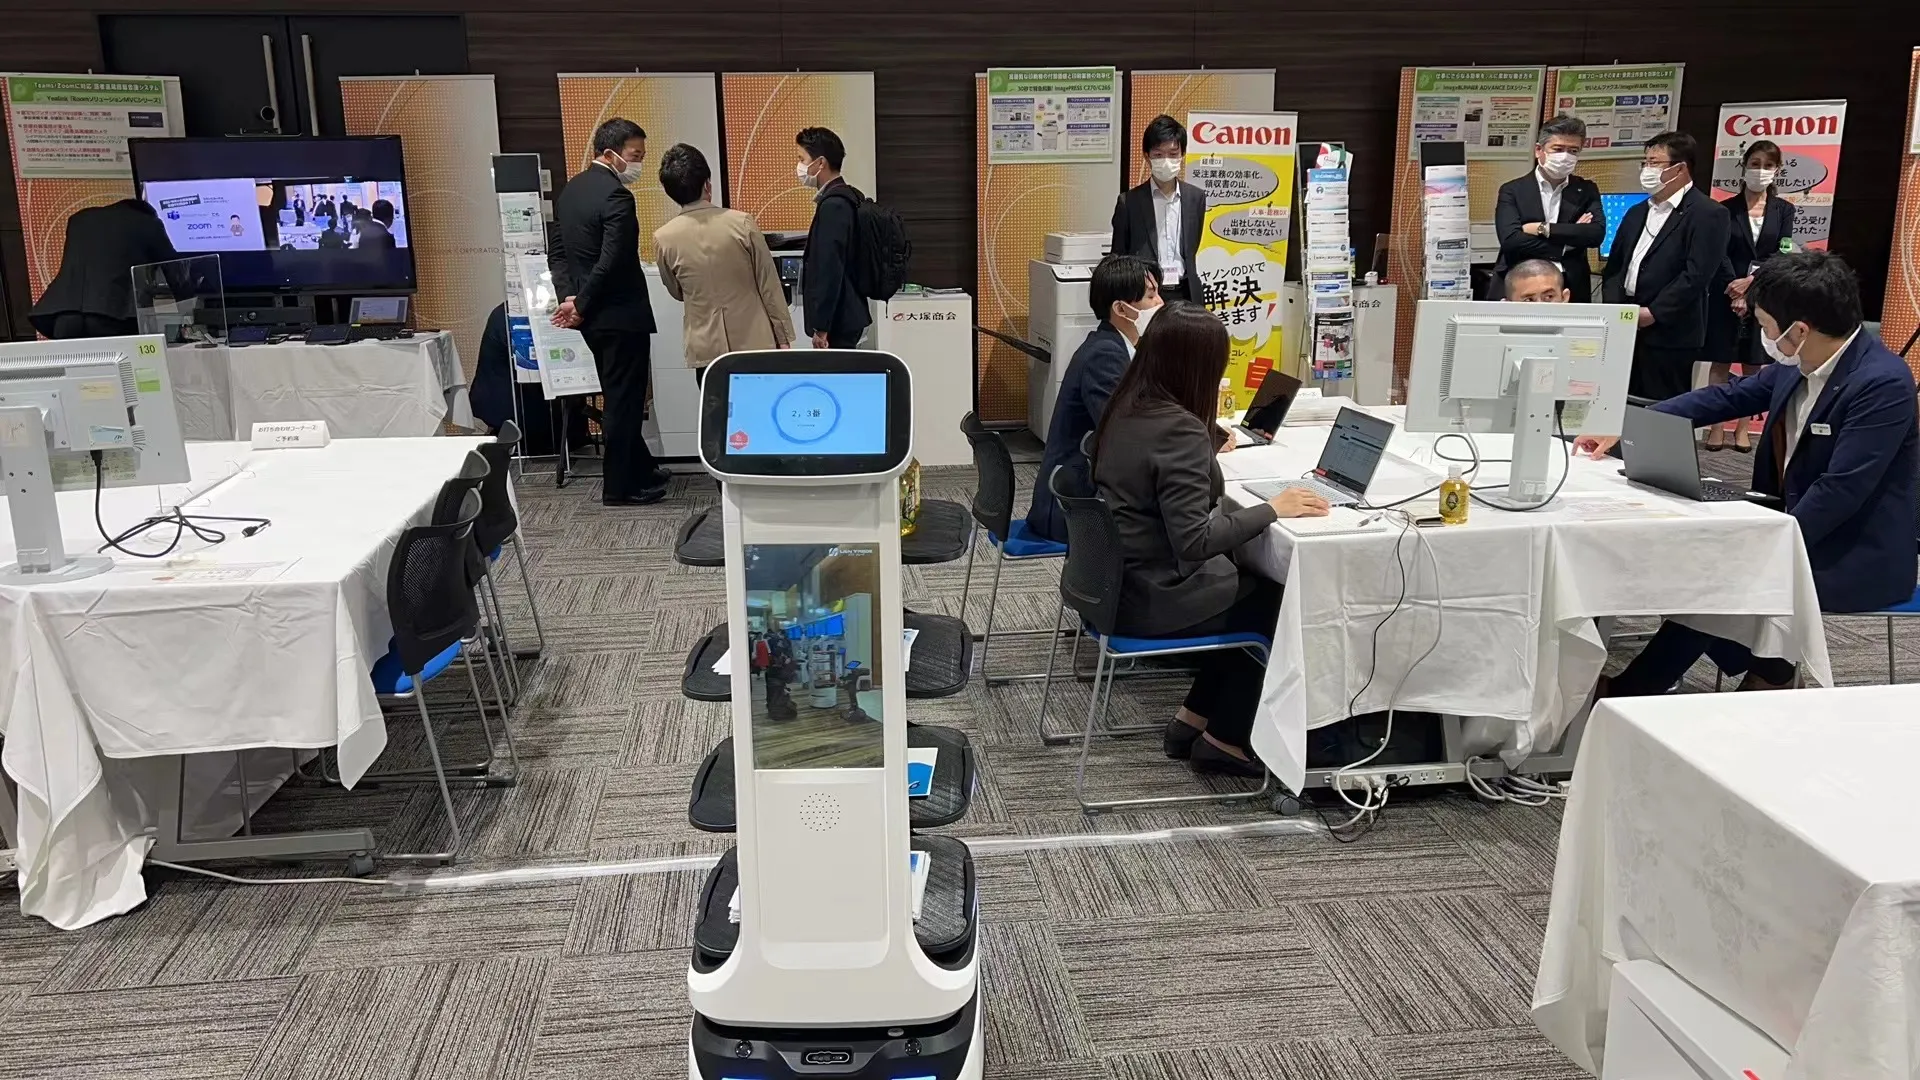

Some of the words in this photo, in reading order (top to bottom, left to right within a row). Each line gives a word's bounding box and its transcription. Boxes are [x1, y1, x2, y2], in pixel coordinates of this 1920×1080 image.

[1725, 114, 1838, 136] Canon
[1192, 122, 1291, 145] Canon
[1230, 219, 1276, 227] 出社しないと
[1222, 228, 1282, 236] 仕事ができない!
[1201, 262, 1265, 281] ヤノンのDXで
[1203, 276, 1263, 312] 解決
[906, 311, 957, 321] 大塚商会
[1218, 305, 1261, 326] きます
[1620, 311, 1633, 320] 143
[139, 344, 155, 354] 130
